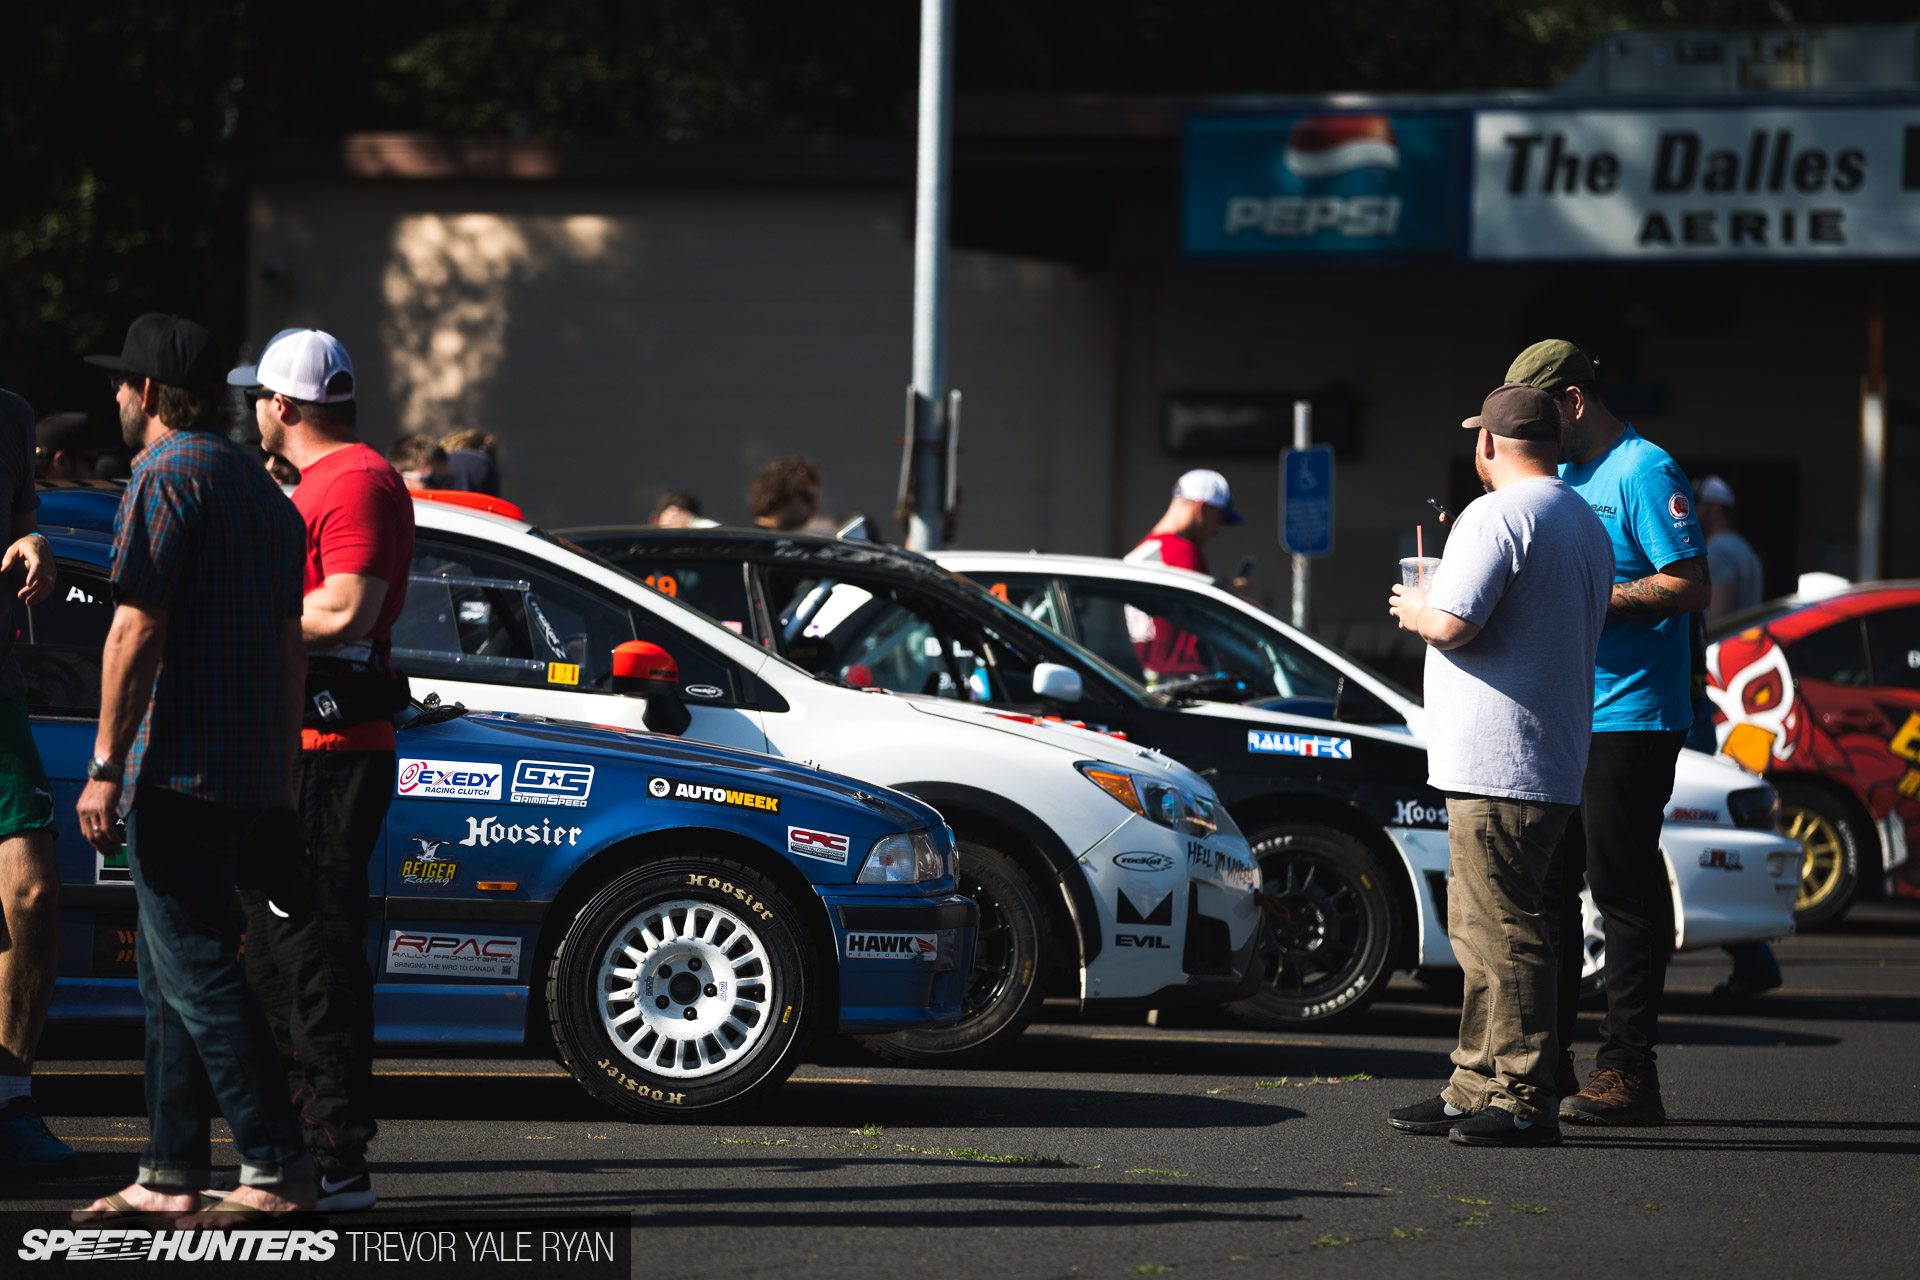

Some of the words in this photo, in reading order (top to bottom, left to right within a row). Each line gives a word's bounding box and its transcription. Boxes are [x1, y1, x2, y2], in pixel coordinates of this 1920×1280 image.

[1504, 130, 1622, 197] The
[1652, 129, 1867, 196] Dalles
[1225, 196, 1402, 239] PEPSI
[1637, 209, 1848, 249] AERIE
[1591, 504, 1617, 514] BARU
[418, 770, 500, 788] EXEDY
[424, 786, 456, 795] RACING
[457, 787, 490, 796] CLUTCH
[675, 783, 779, 812] AUTOWEEK
[1391, 799, 1449, 825] Hoos
[458, 815, 583, 847] Hoosier
[790, 829, 847, 851] CRC
[403, 873, 453, 885] Racing
[686, 873, 774, 922] Hoosier
[392, 935, 518, 958] RPAC
[848, 935, 914, 953] HAWK
[1115, 934, 1171, 949] EVIL
[394, 961, 427, 969] BRINGING
[468, 965, 495, 973] CANADA
[597, 1058, 687, 1105] Hoosier
